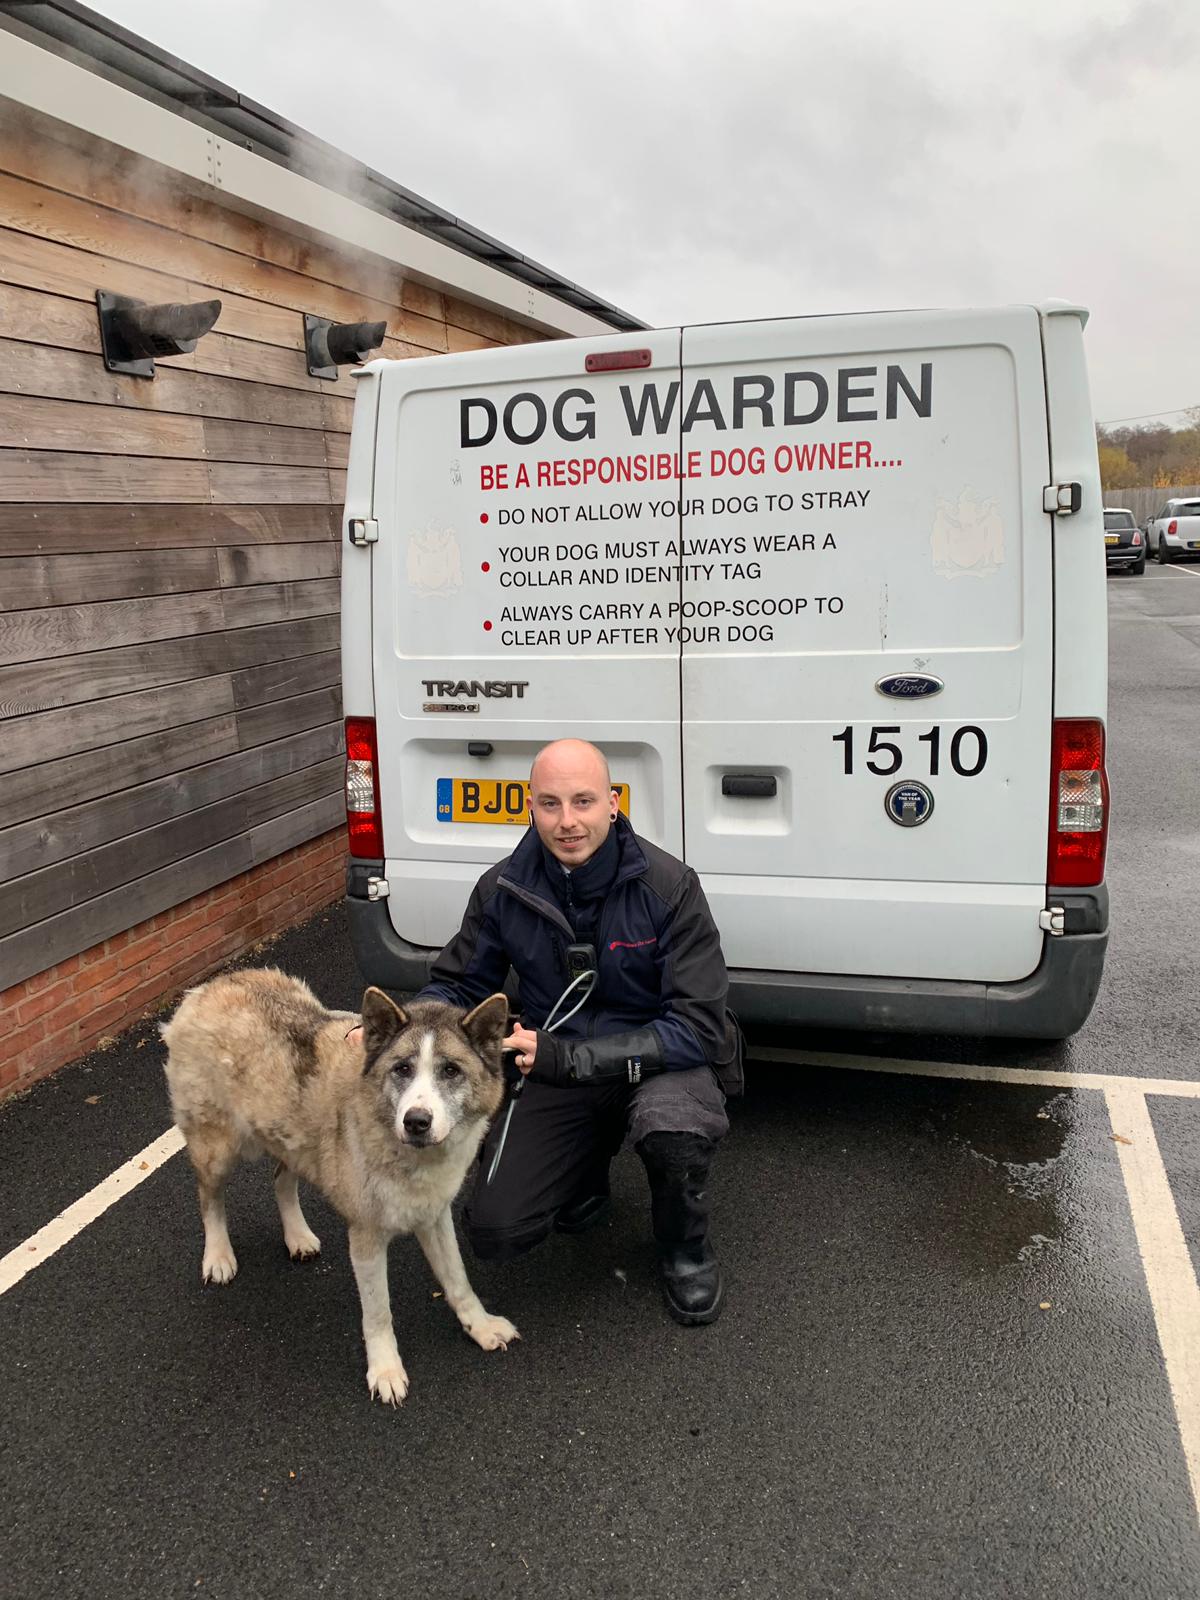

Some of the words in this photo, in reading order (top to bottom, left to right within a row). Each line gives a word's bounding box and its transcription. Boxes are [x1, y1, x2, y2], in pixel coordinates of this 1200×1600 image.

[460, 388, 596, 449] DOG
[619, 362, 933, 437] WARDEN
[480, 463, 508, 491] BE
[515, 462, 530, 489] A
[537, 451, 702, 488] RESPONSIBLE
[710, 446, 765, 477] DOG
[498, 508, 525, 525] DO
[531, 506, 571, 524] NOT
[575, 502, 643, 522] ALLOW
[648, 498, 705, 518] YOUR
[712, 495, 759, 514] DOG
[764, 494, 794, 512] TO
[800, 489, 871, 510] STRAY
[498, 545, 550, 563] YOUR
[556, 543, 599, 561] DOG
[605, 541, 660, 559] MUST
[664, 537, 747, 557] ALWAYS
[752, 533, 816, 553] WEAR
[822, 532, 837, 550] A
[499, 569, 573, 588] COLLAR
[578, 568, 619, 585] AND
[625, 564, 715, 584] IDENTITY
[719, 562, 761, 580] TAG
[500, 604, 573, 622] ALWAYS
[579, 602, 645, 621] CARRY
[648, 602, 662, 619] A
[668, 598, 808, 619] POOP-SCOOP
[814, 596, 844, 614] TO
[501, 629, 561, 647] CLEAR
[567, 629, 592, 646] UP
[596, 627, 659, 645] AFTER
[663, 626, 721, 644] YOUR
[727, 625, 774, 642] DOG
[421, 680, 529, 698] TRANSIT
[890, 677, 929, 694] Ford
[462, 782, 530, 814] BJ0
